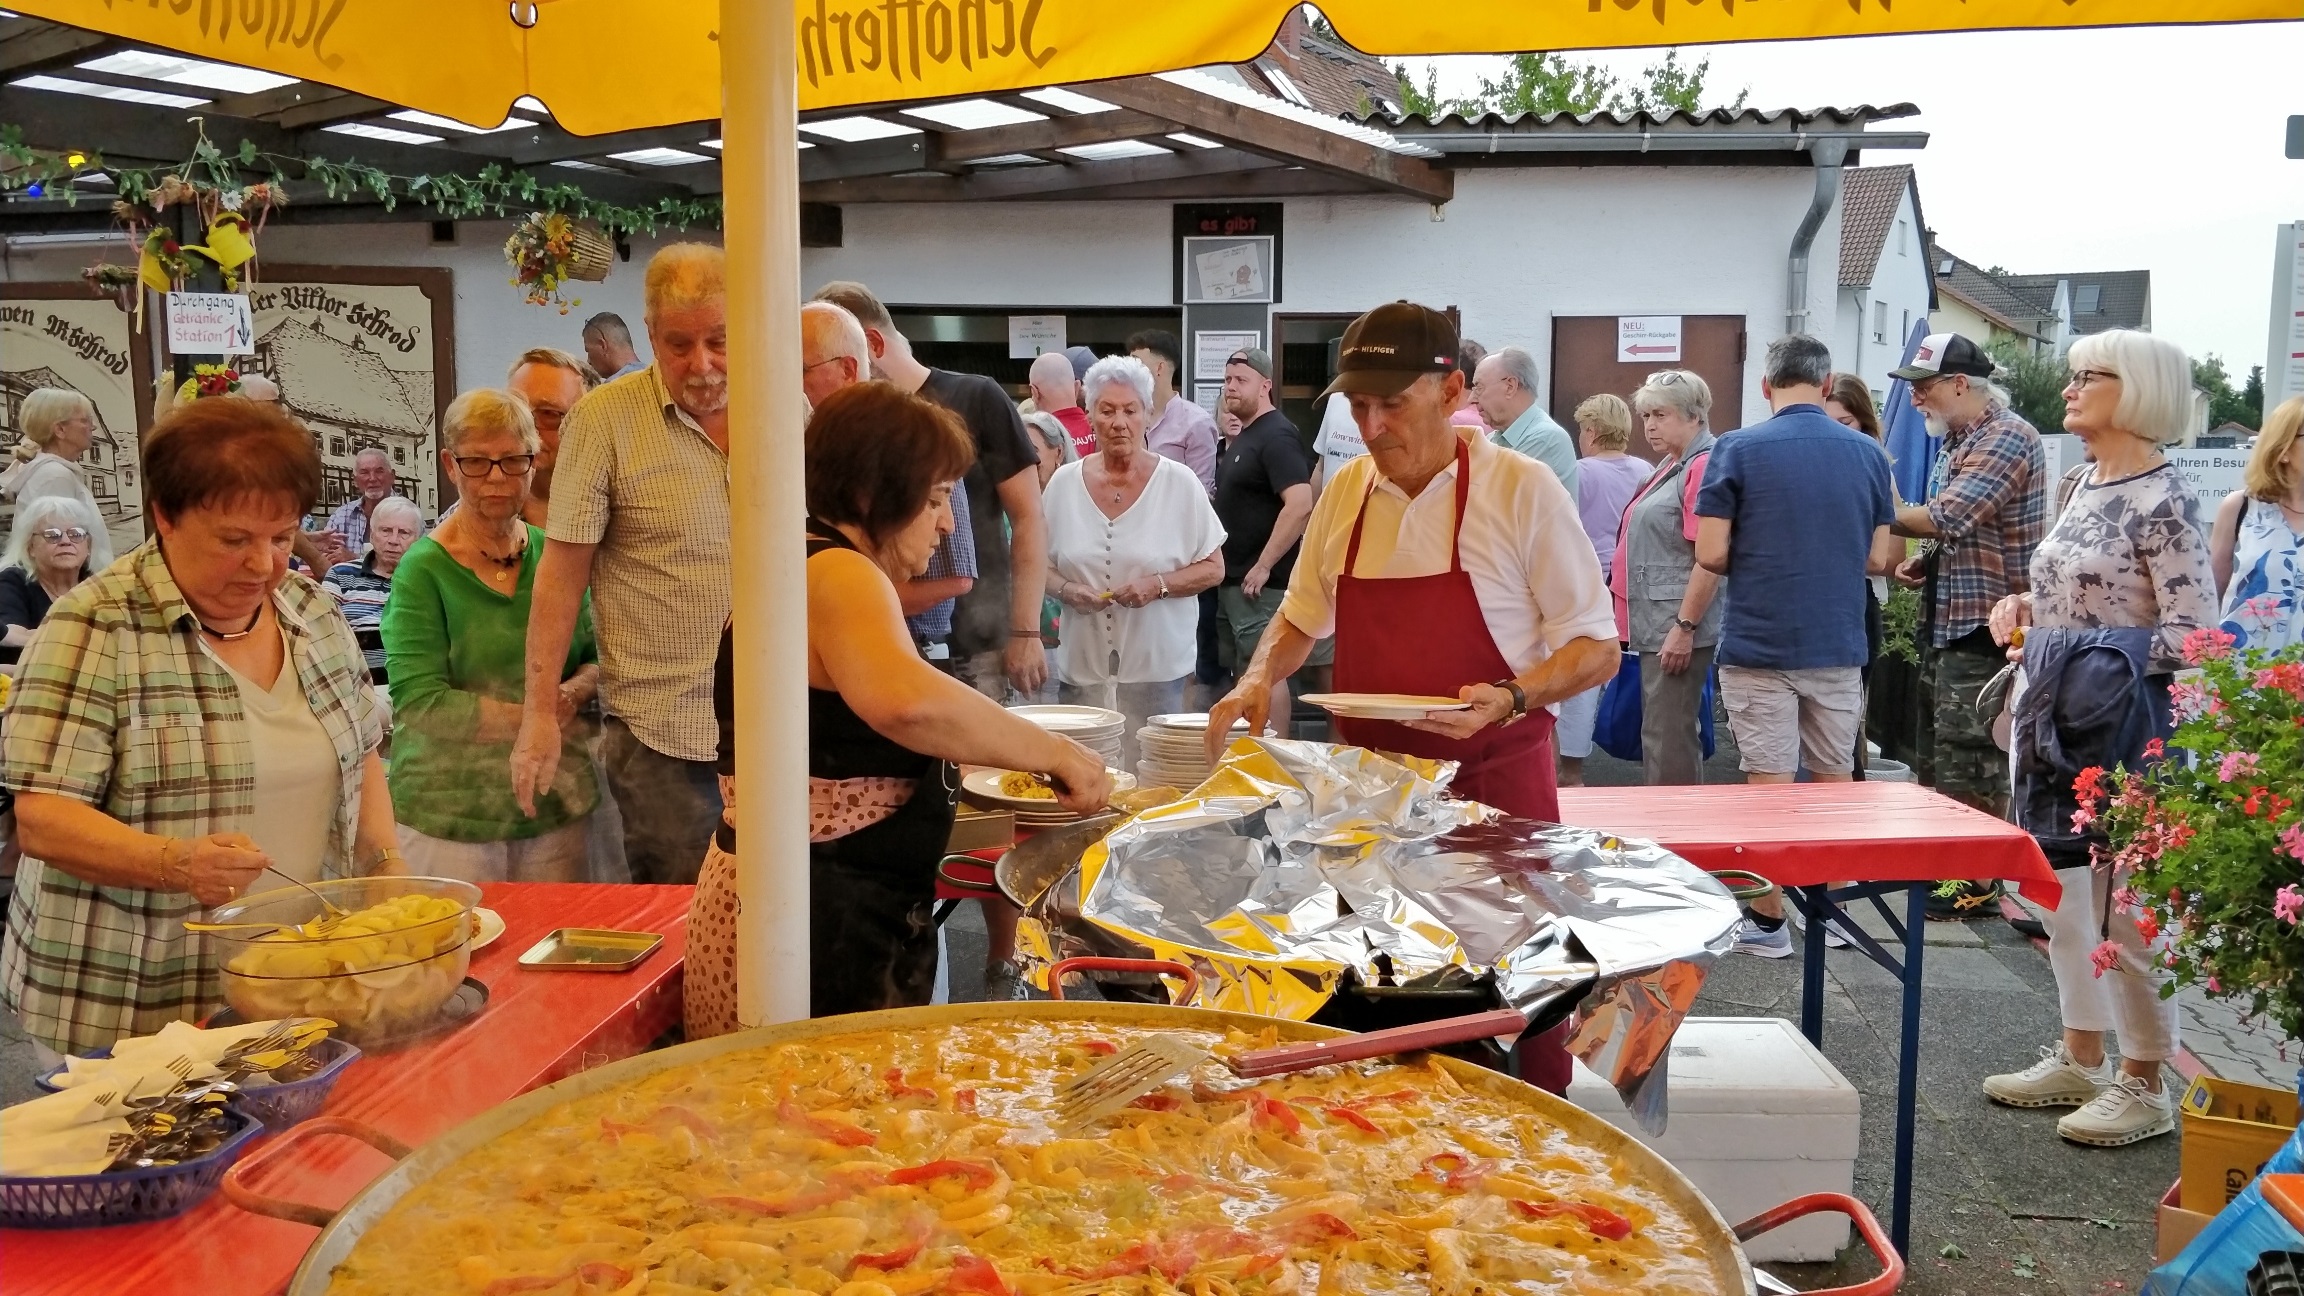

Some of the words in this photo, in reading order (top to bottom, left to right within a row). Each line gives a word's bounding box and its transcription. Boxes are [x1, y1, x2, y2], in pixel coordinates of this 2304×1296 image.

[1224, 217, 1257, 235] gibt
[171, 293, 235, 316] Durchgang
[280, 286, 348, 316] Viktor
[1623, 322, 1645, 330] NEU:
[175, 327, 222, 342] Station
[1622, 331, 1677, 339] Geschirr-Rückgabe
[1361, 346, 1395, 354] HILFIGER
[2176, 457, 2209, 468] Ihren
[2213, 457, 2249, 468] Besu
